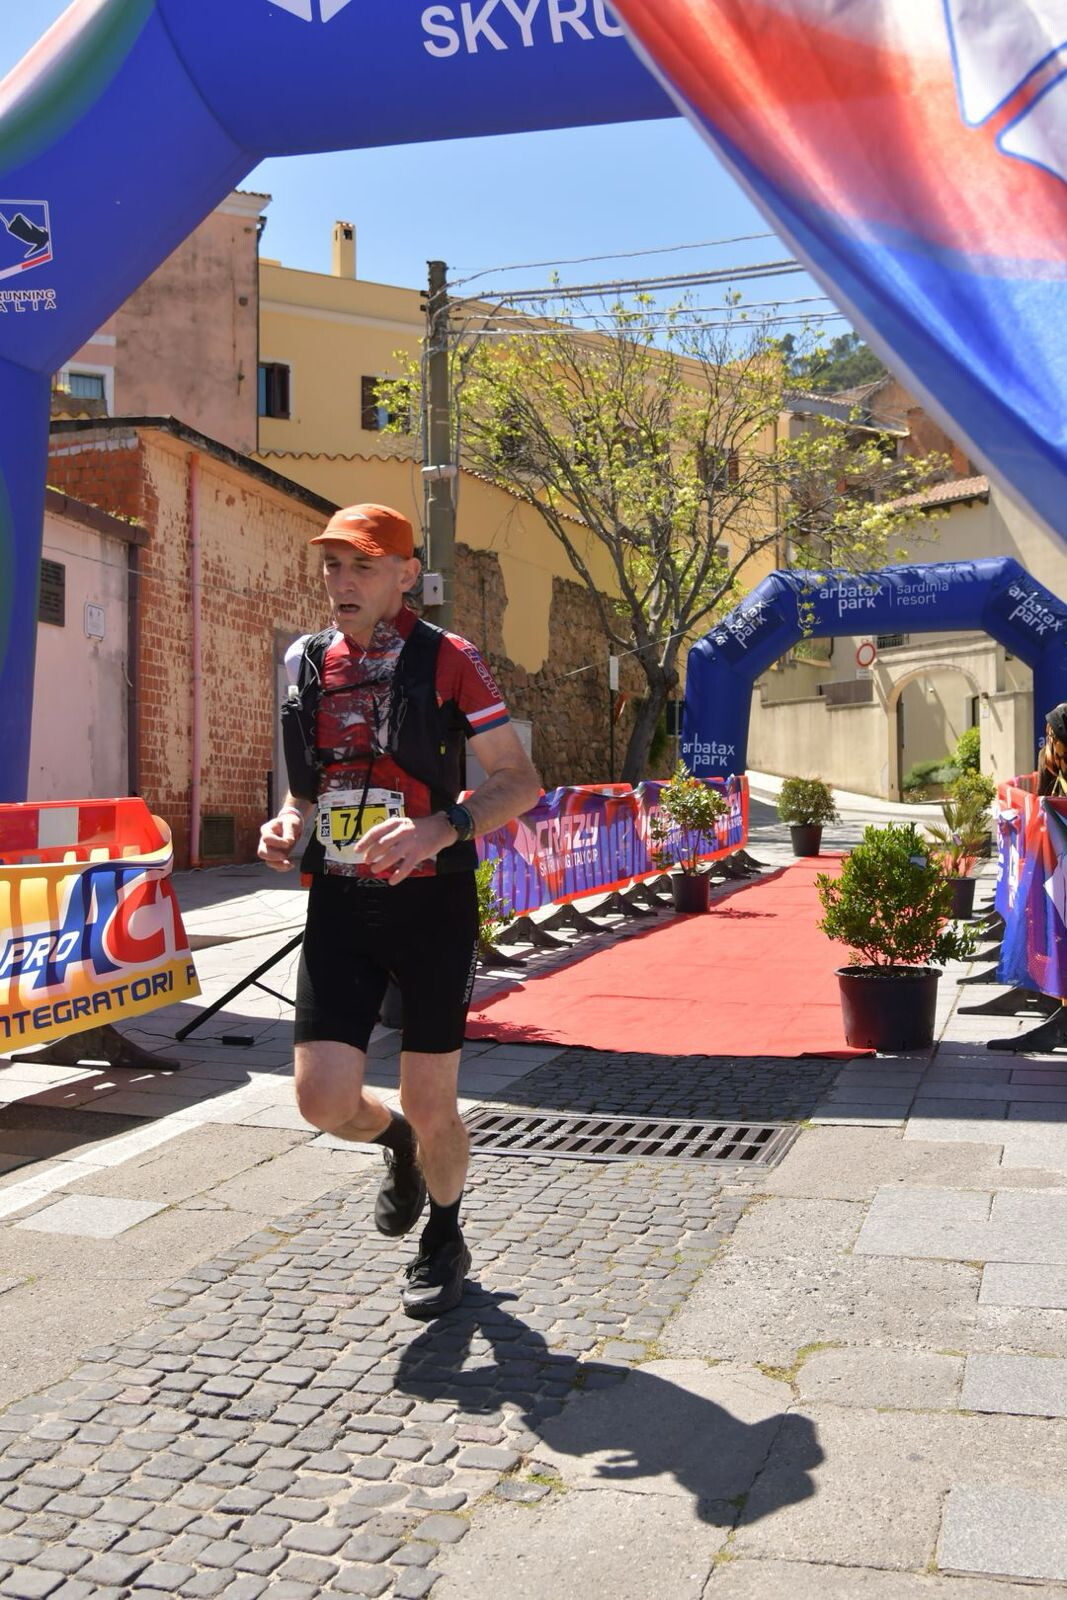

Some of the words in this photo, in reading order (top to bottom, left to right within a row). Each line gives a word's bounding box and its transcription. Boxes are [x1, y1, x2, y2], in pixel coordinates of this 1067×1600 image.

[820, 580, 884, 599] arbatax
[897, 581, 950, 595] sardinia
[897, 592, 937, 606] resort
[838, 597, 876, 618] park
[1008, 585, 1063, 632] arbatax
[734, 613, 768, 649] park
[1008, 605, 1048, 636] park
[682, 732, 735, 756] arbatax
[693, 754, 727, 772] park
[0, 931, 80, 976] PRO
